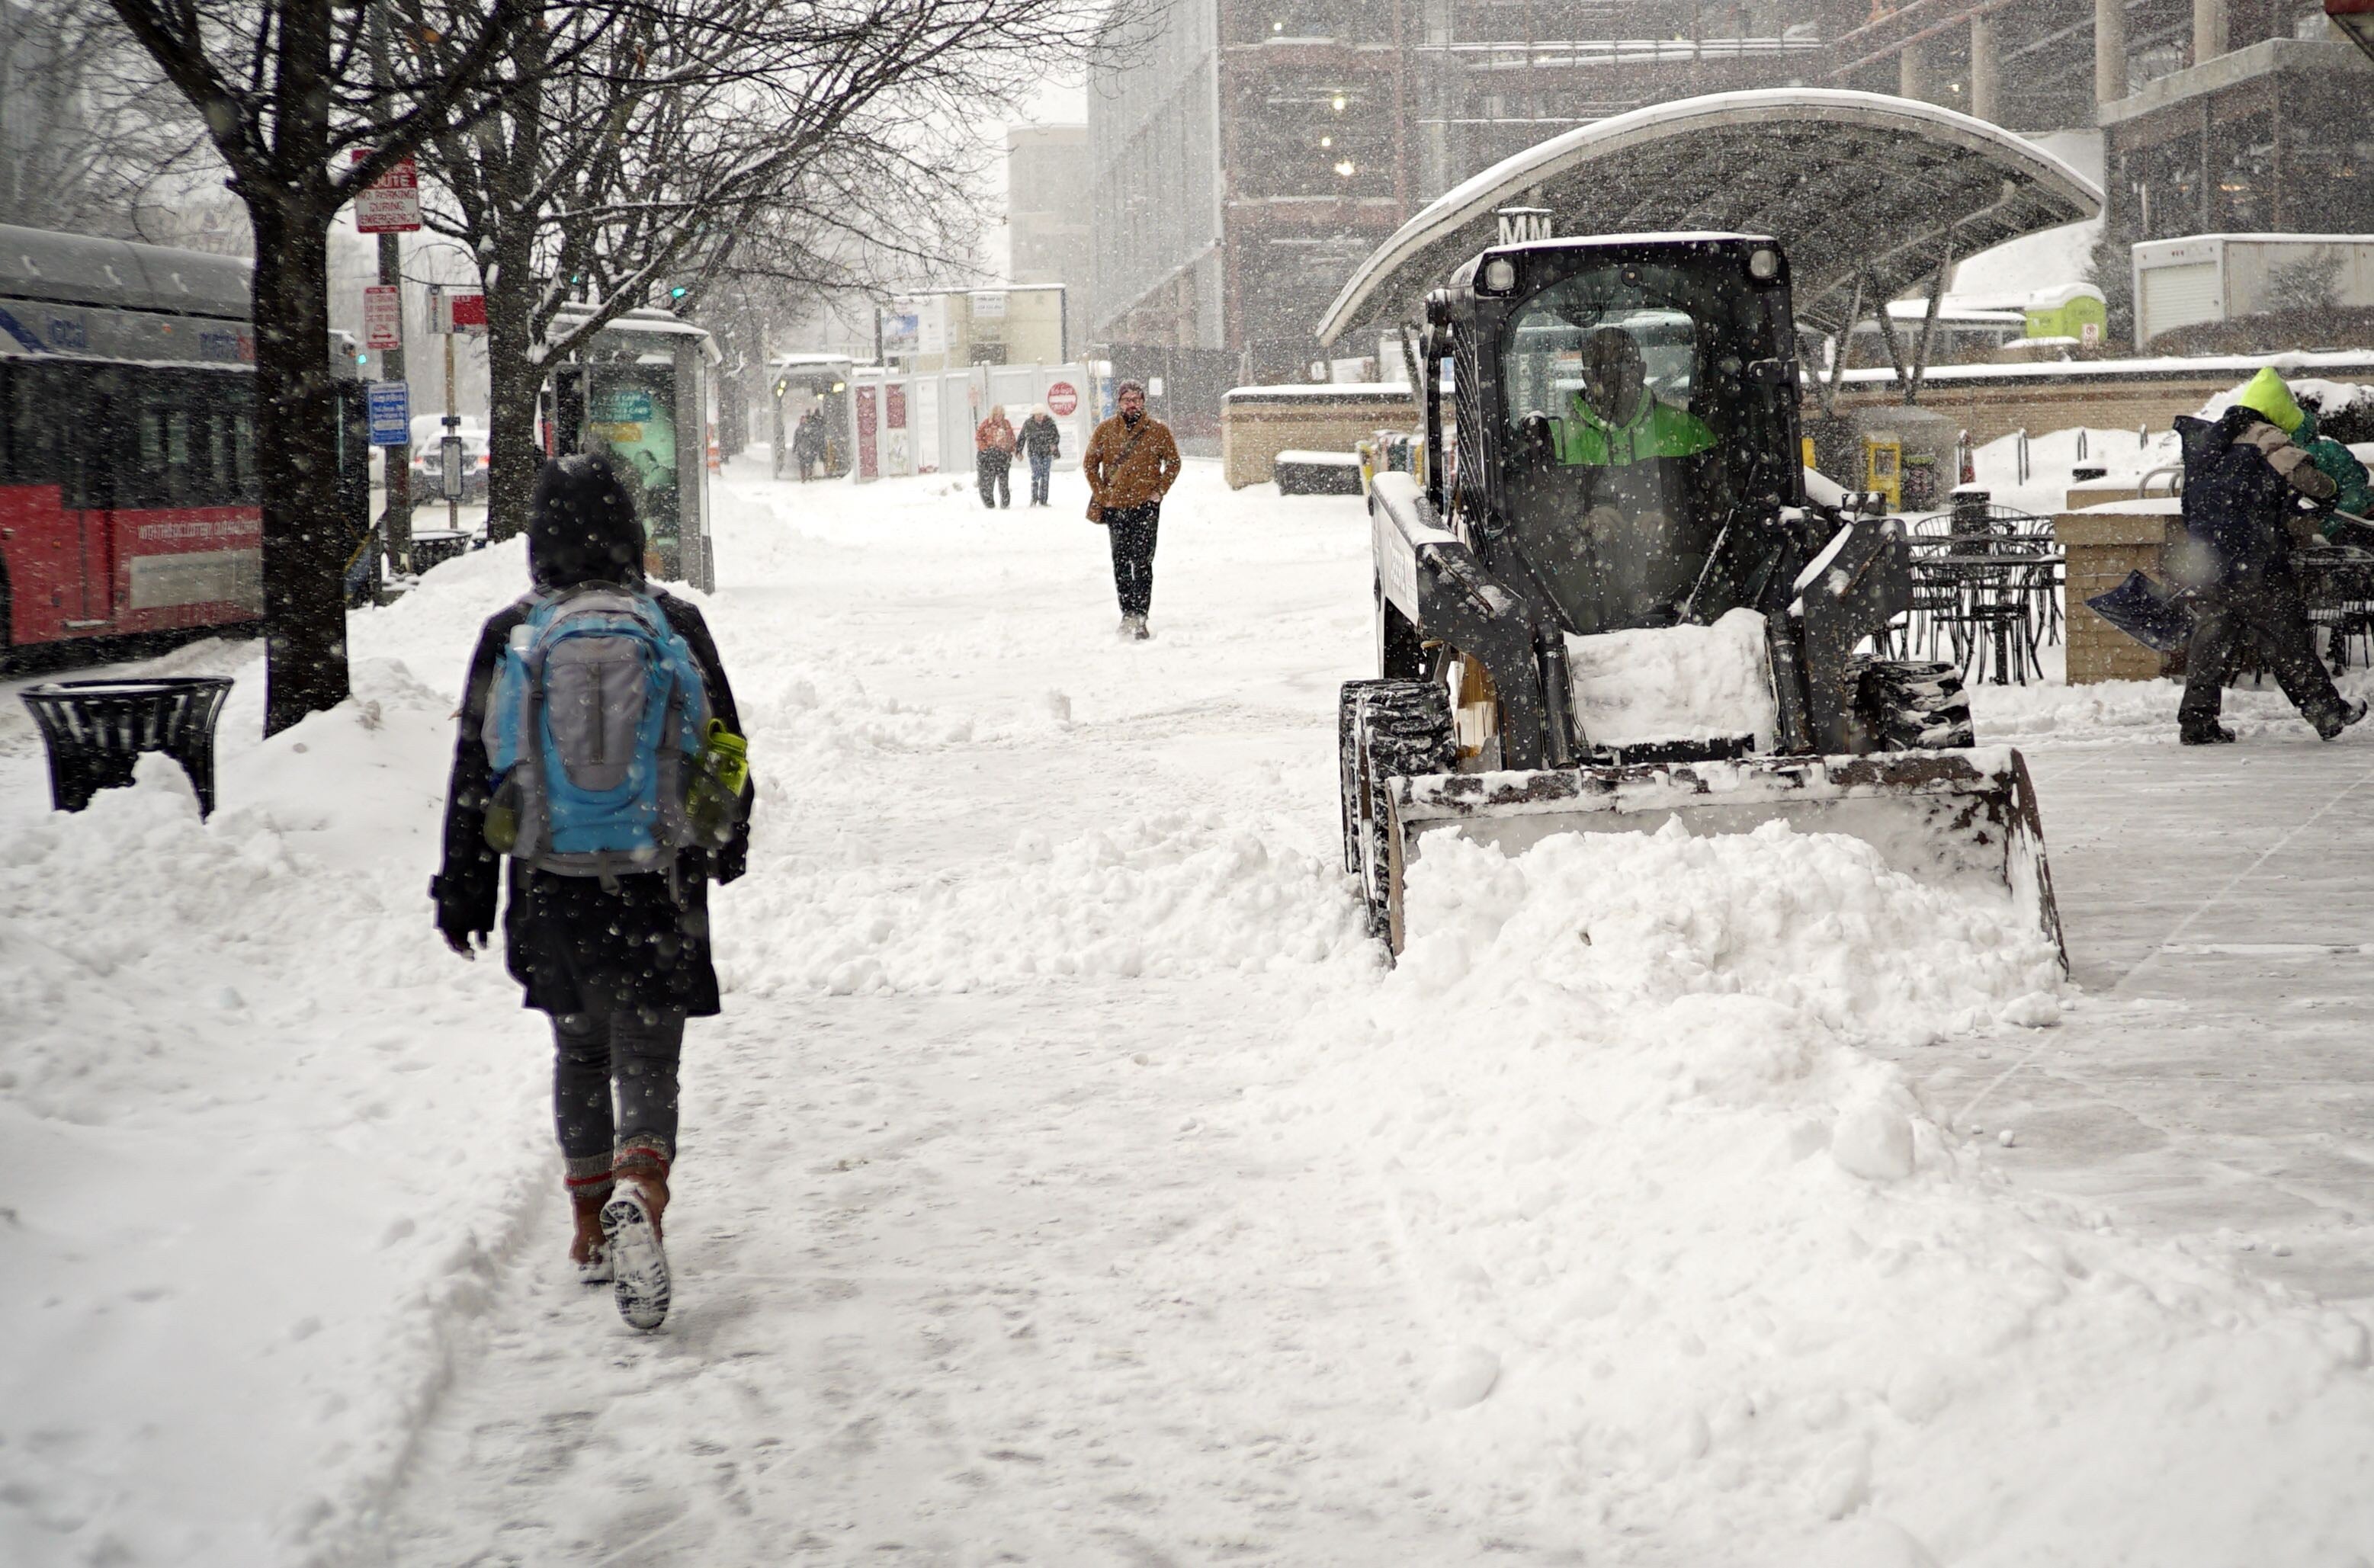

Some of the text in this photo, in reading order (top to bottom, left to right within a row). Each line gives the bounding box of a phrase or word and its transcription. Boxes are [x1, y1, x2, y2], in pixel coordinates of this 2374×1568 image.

[374, 188, 415, 199] PARKING
[369, 200, 406, 212] DURING
[359, 213, 416, 225] EMERGENCY
